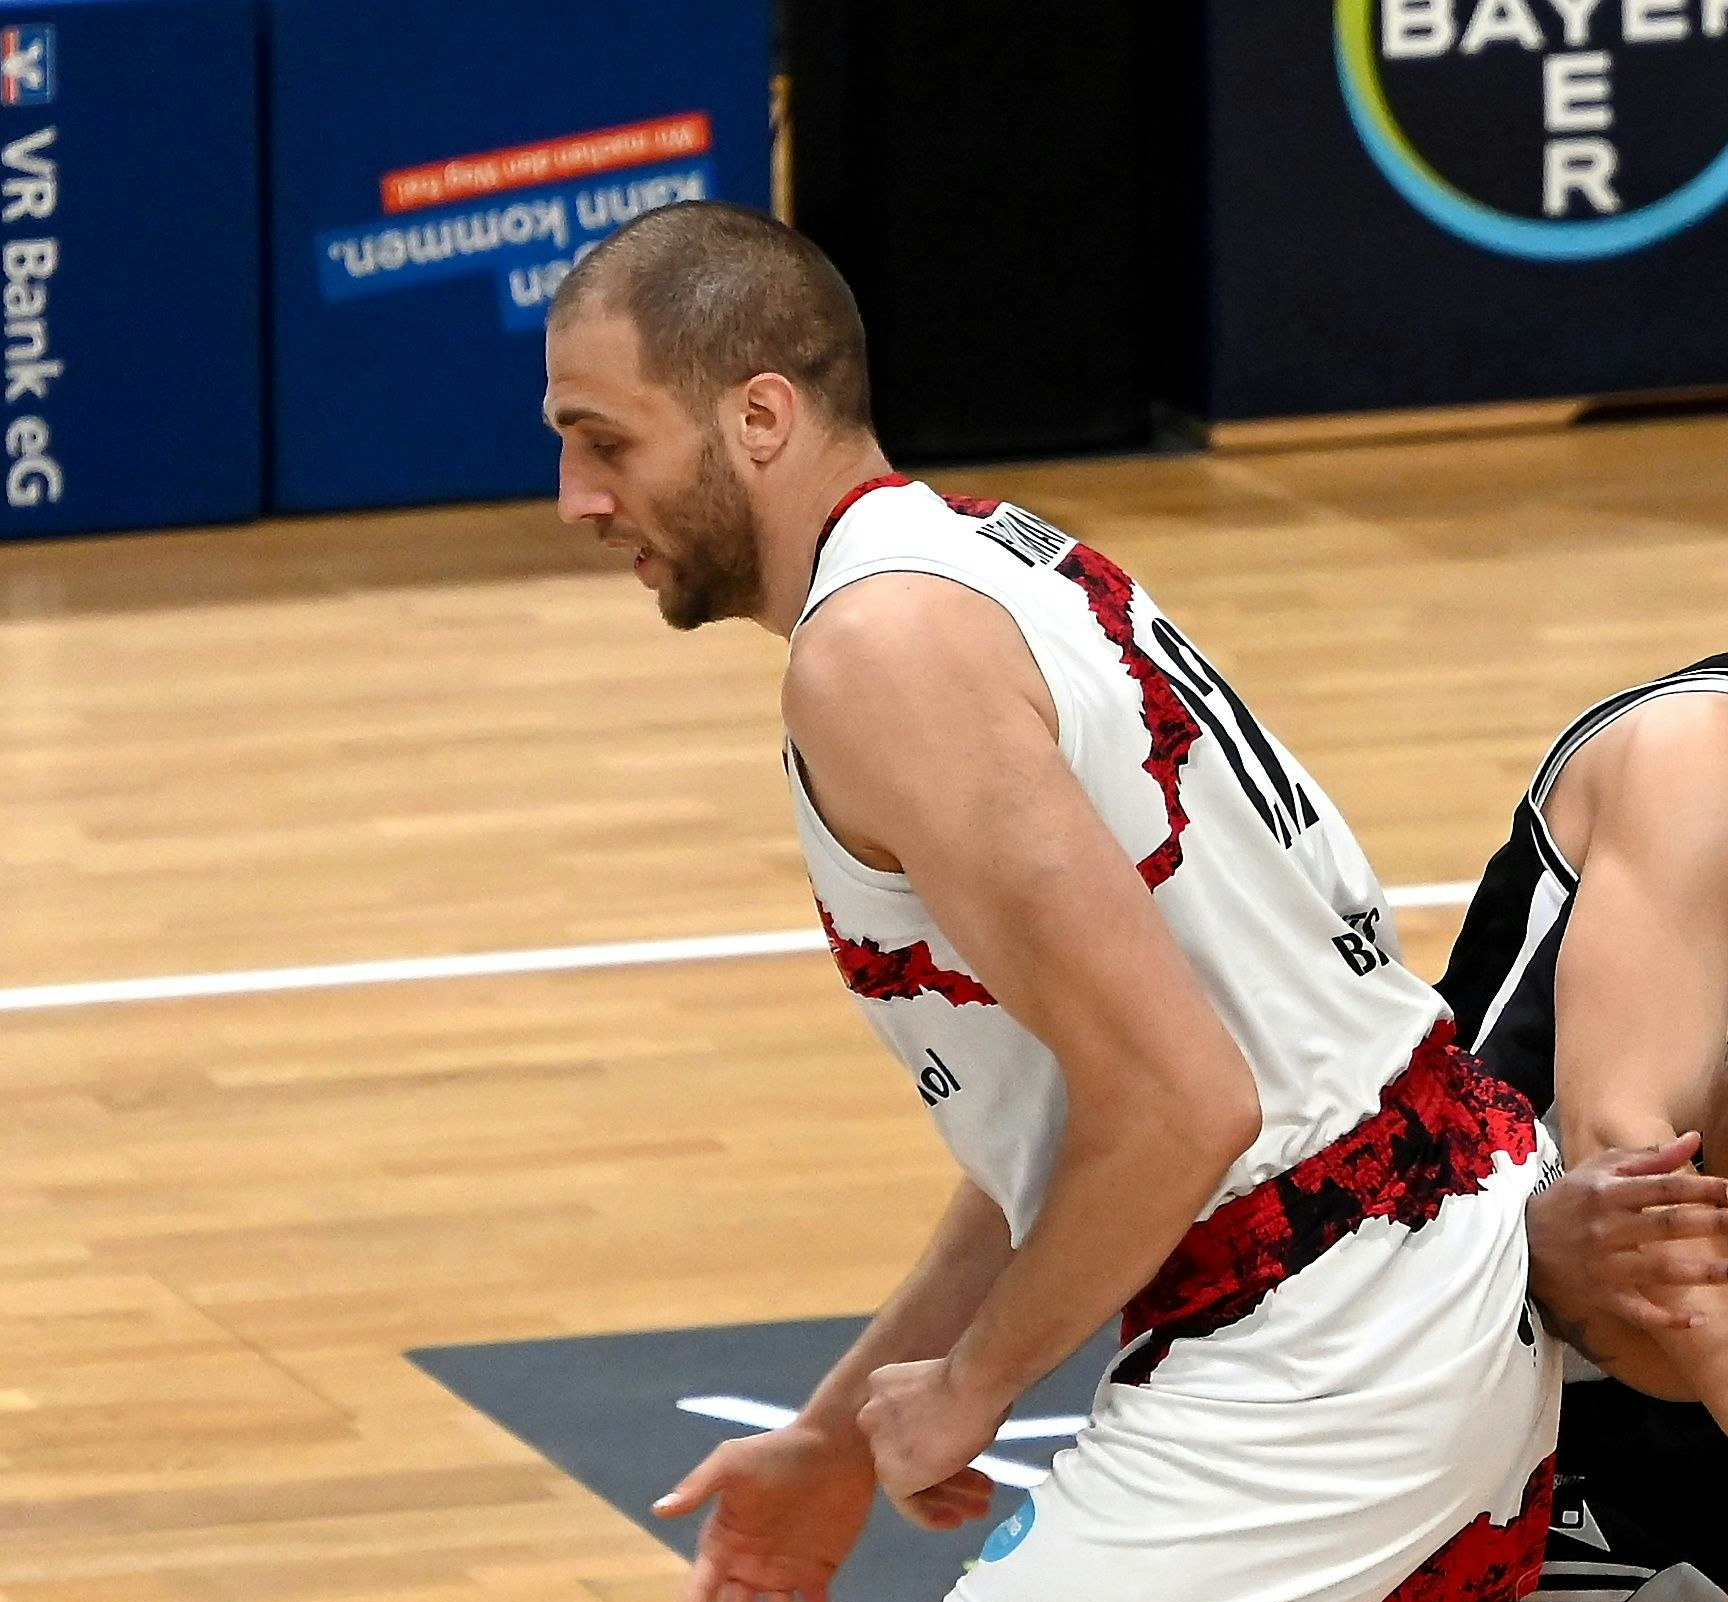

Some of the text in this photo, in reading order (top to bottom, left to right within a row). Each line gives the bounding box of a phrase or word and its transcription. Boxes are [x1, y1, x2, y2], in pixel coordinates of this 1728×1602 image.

[1, 124, 64, 507] VR Bank eG
[328, 197, 568, 278] kommen.
